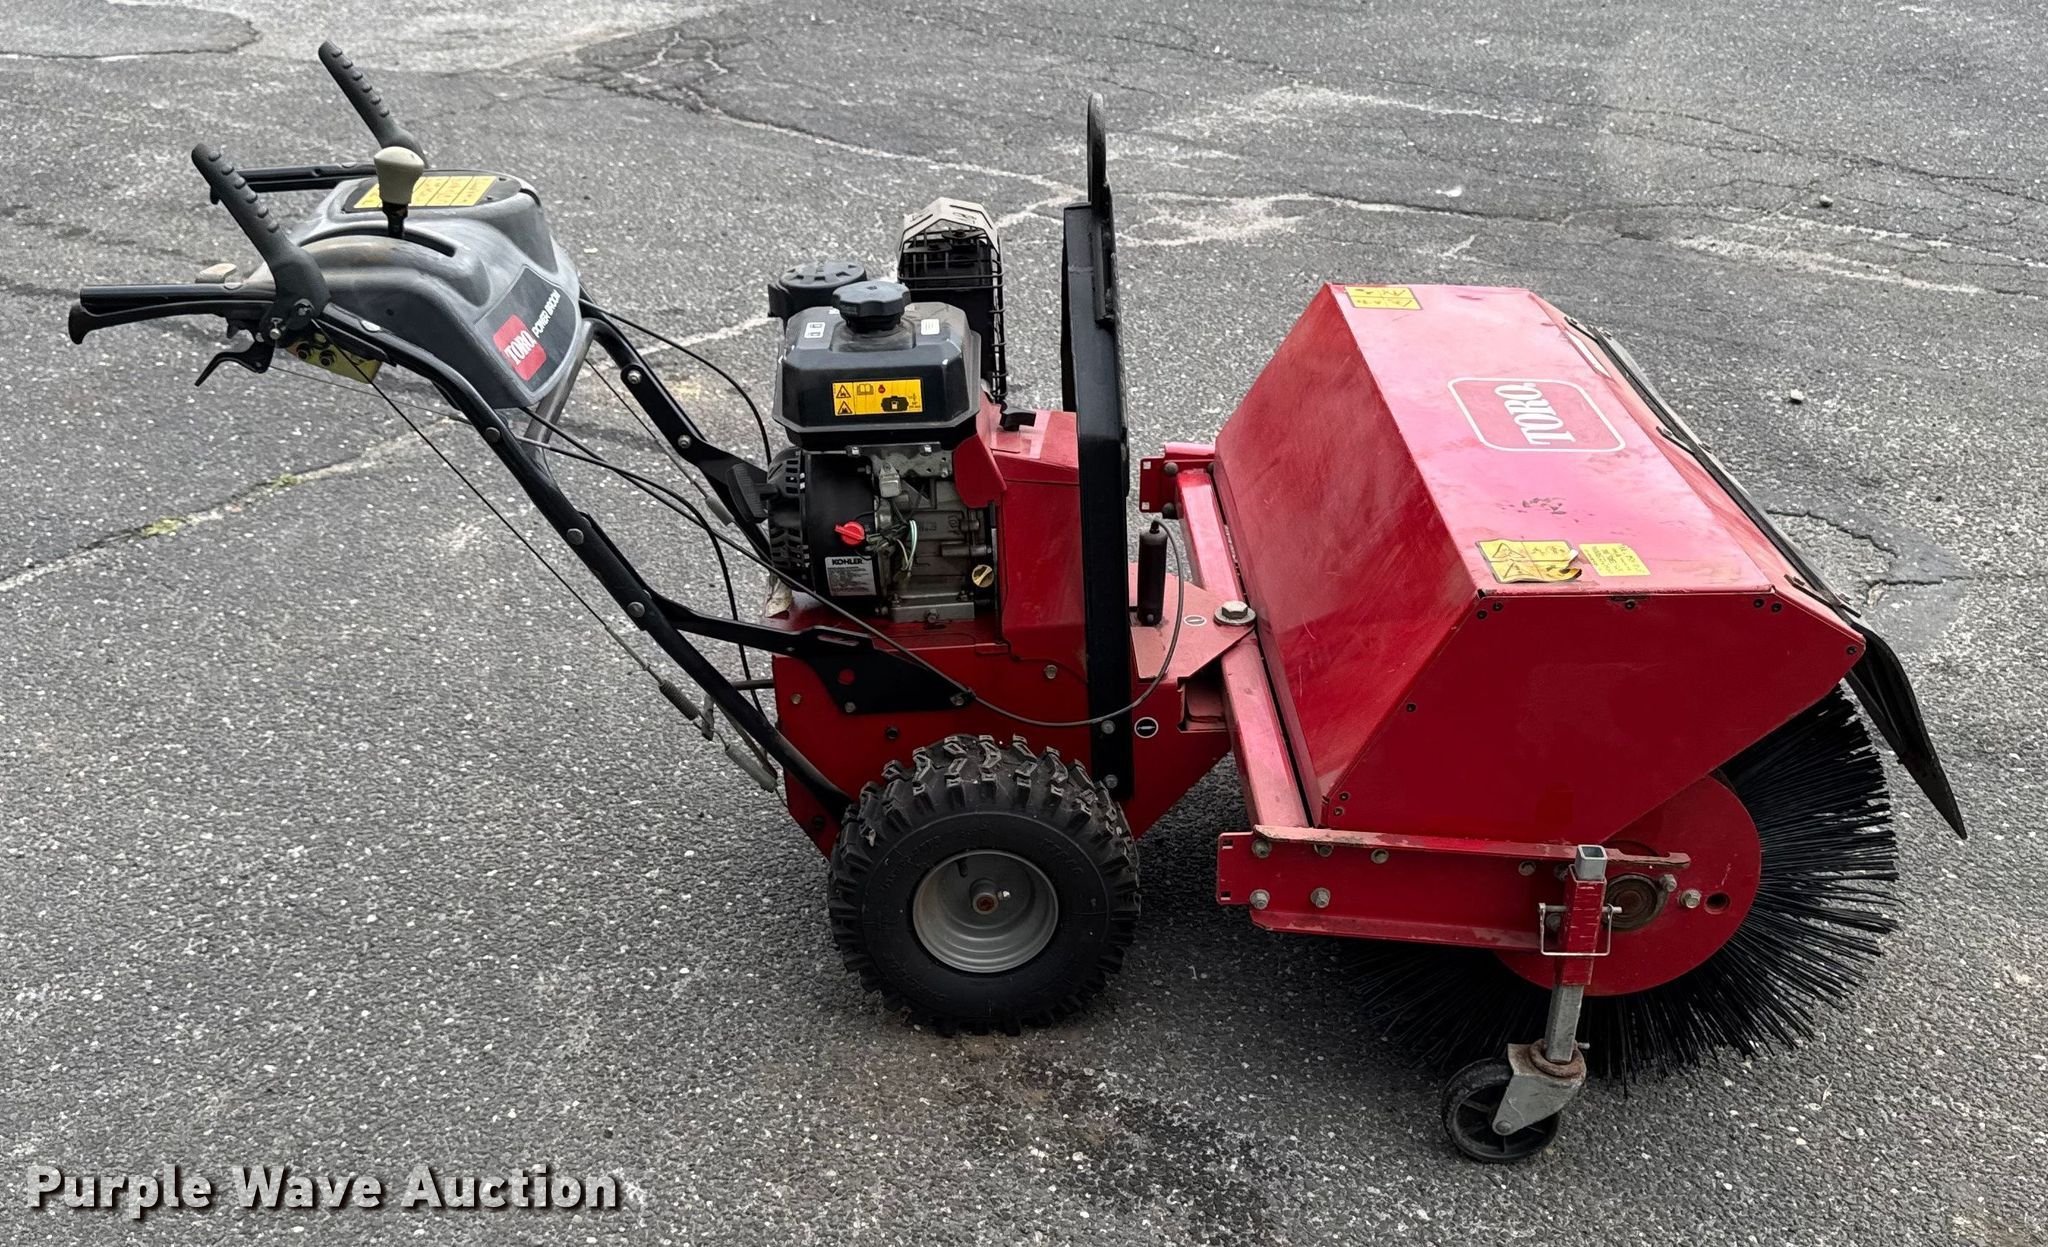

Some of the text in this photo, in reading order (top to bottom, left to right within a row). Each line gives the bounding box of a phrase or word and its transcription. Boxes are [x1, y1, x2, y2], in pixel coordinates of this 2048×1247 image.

[531, 289, 561, 338] POWER BROOM
[832, 558, 864, 566] KOHLER
